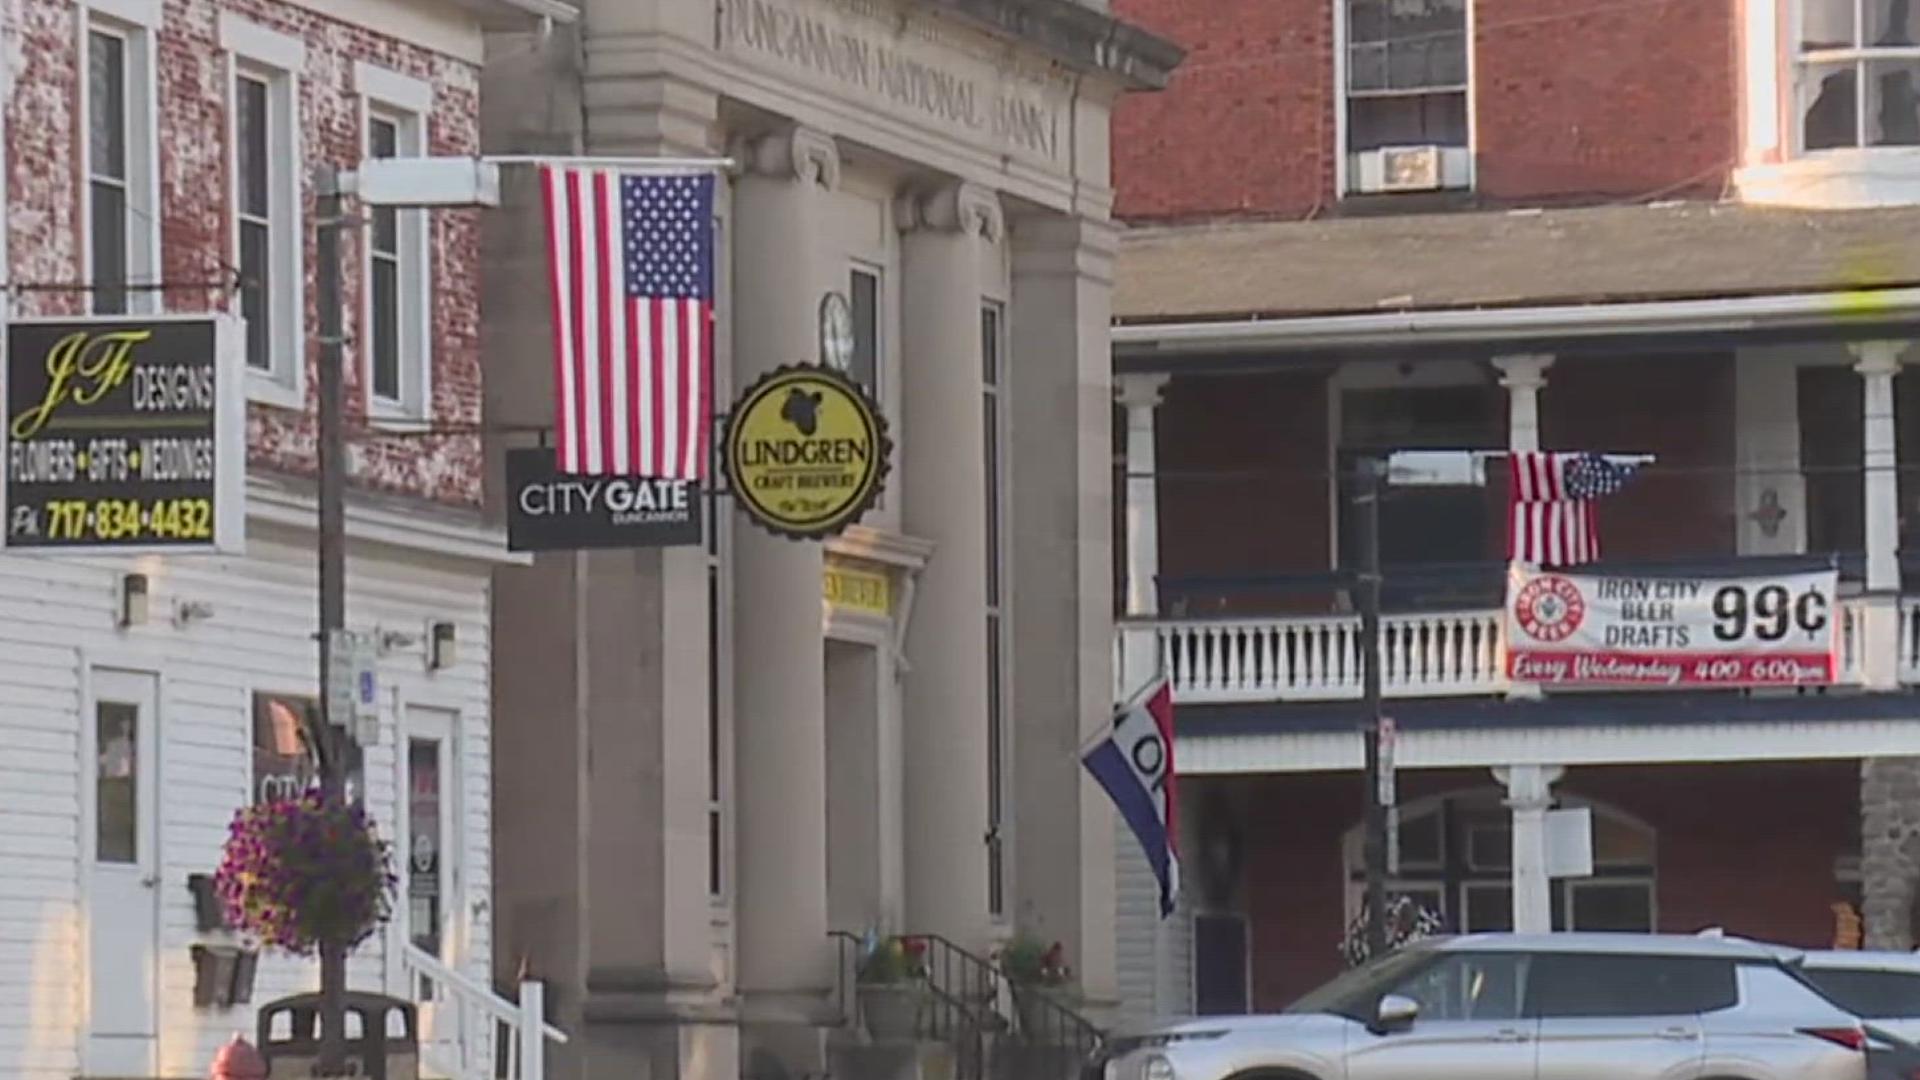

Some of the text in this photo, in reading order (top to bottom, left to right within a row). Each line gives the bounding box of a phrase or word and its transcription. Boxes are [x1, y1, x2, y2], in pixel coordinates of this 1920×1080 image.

[876, 47, 986, 130] NATIONAL
[132, 365, 213, 411] DESIGNS
[9, 438, 213, 482] FLOWERS GIFTS WEDDINGS
[741, 438, 866, 466] LINDGREN
[753, 473, 855, 490] CRAFT BREWERY
[520, 479, 689, 516] CITY GATE
[612, 510, 690, 525] DUNCANNON
[1597, 578, 1702, 599] IRON CITY
[1620, 601, 1674, 622] BEER
[1712, 583, 1827, 642] 99¢
[1605, 624, 1690, 647] DRAFTS
[1512, 653, 1568, 683] Every
[1573, 654, 1682, 686] Wednesday
